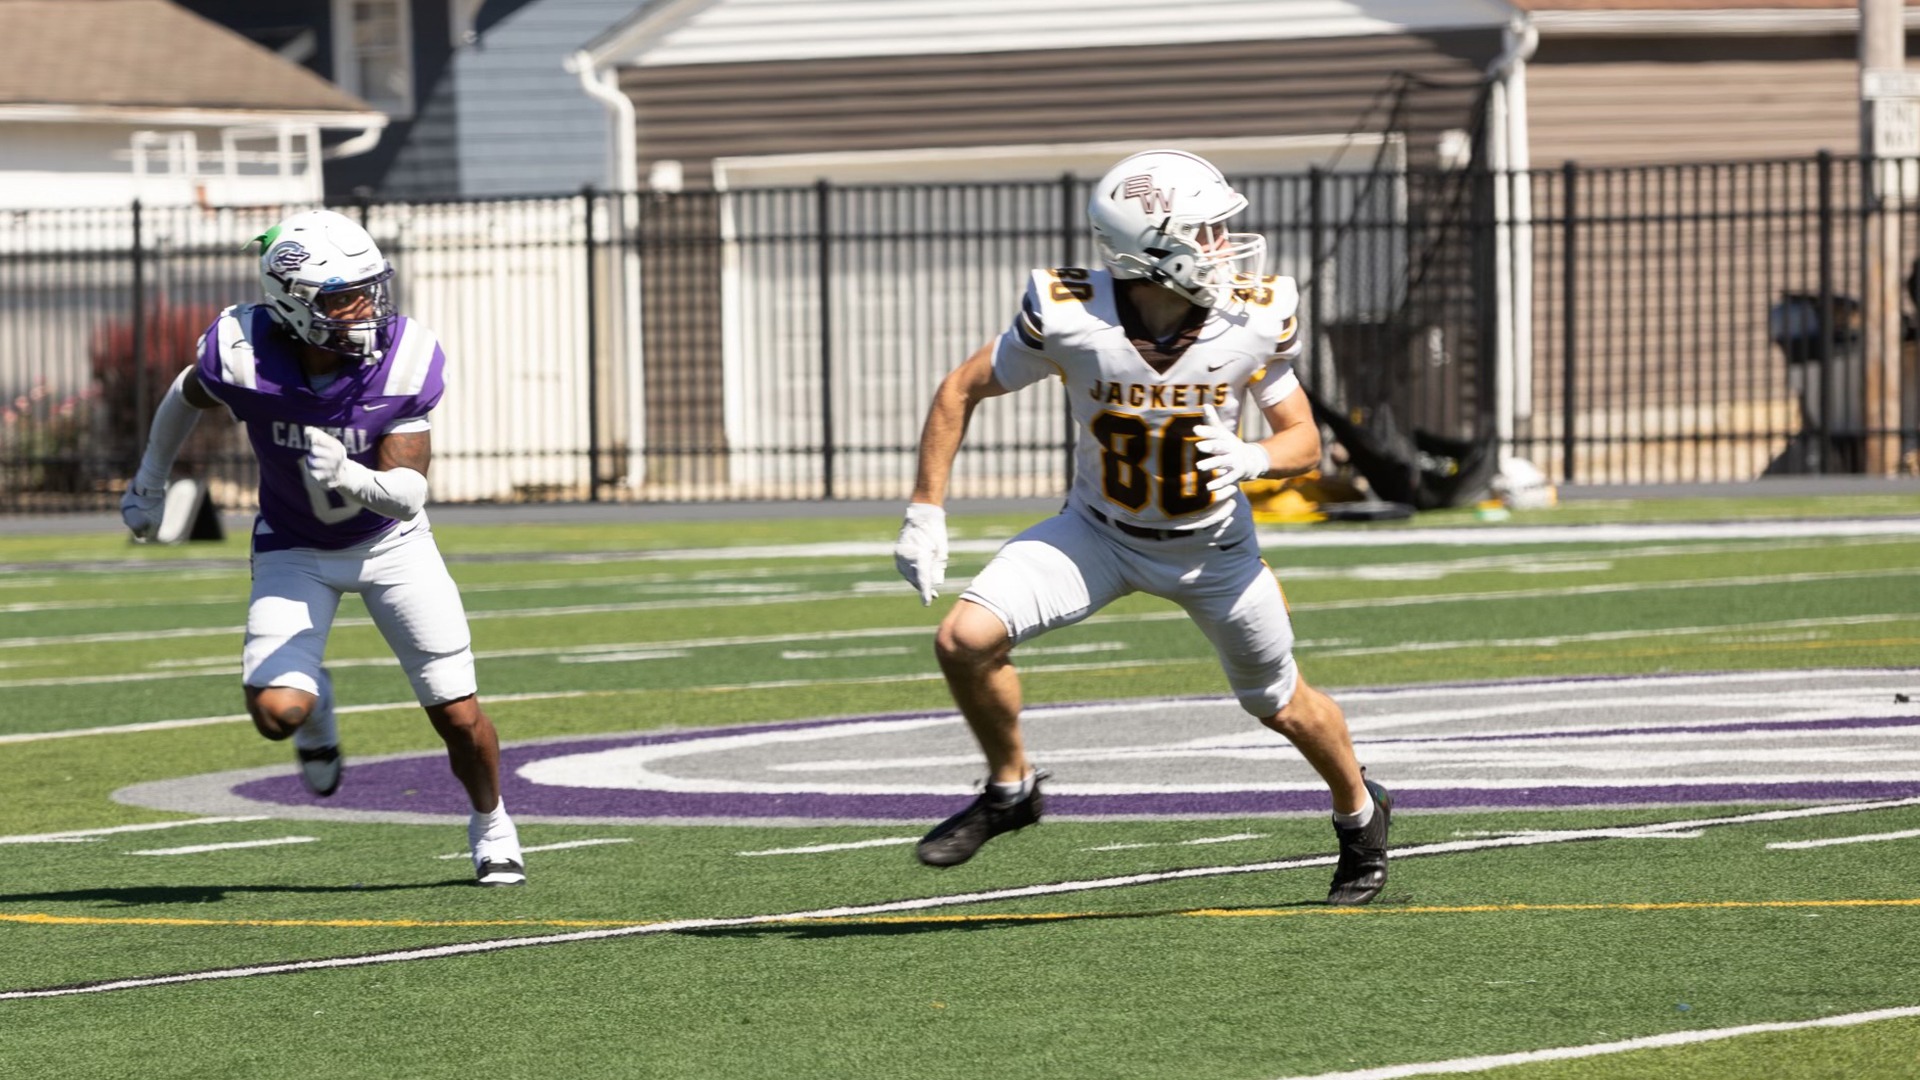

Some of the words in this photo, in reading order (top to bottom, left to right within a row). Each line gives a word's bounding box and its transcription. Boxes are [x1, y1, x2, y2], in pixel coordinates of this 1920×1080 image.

[1124, 174, 1176, 215] BW
[1089, 379, 1231, 410] JACKETS
[1091, 409, 1218, 519] 80
